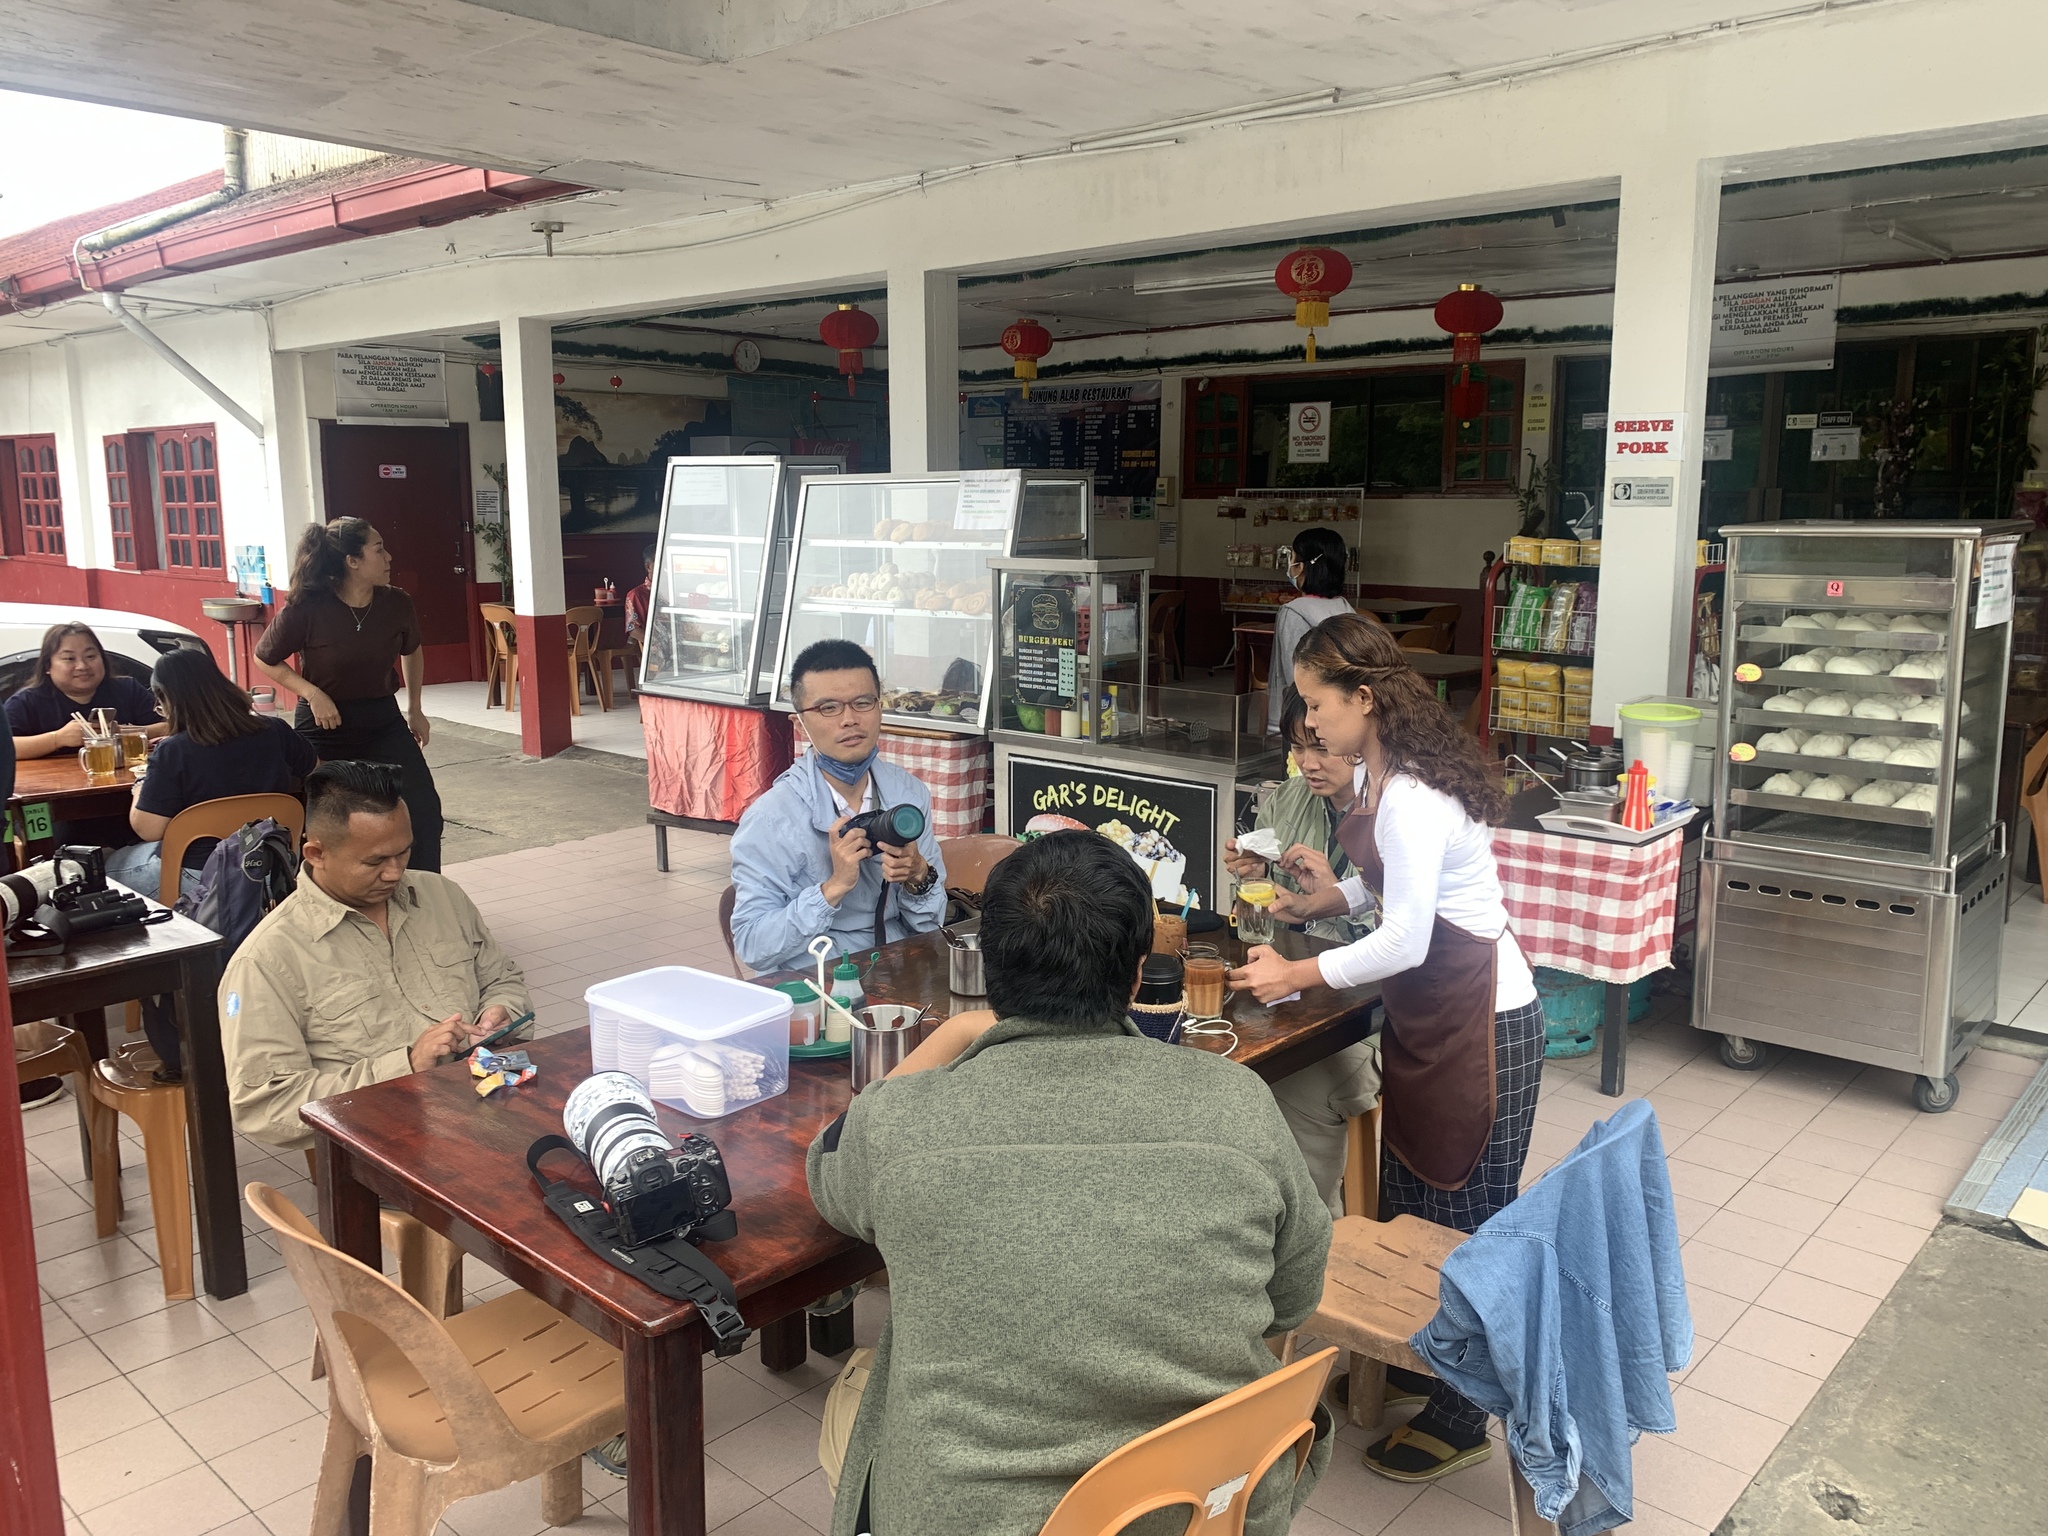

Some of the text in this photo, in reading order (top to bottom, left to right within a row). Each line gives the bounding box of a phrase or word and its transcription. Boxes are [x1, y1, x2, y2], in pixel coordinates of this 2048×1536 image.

[1295, 258, 1319, 281] 福
[1719, 292, 1764, 301] PELANGGAN
[1790, 284, 1833, 293] DIHORMATI
[1723, 310, 1778, 319] MENGELAKKAN
[1781, 304, 1824, 313] KESESAKAN
[1730, 303, 1776, 312] KEDUDUKAN
[1028, 386, 1133, 404] GUNUNG ALAB RESTAURANT
[1614, 420, 1674, 432] SERVE
[1617, 442, 1668, 454] PORK
[1831, 583, 1839, 592] Q
[1019, 635, 1073, 646] BURGER MENU
[1033, 781, 1180, 836] GAR'S DELIGHT
[27, 817, 47, 833] 16
